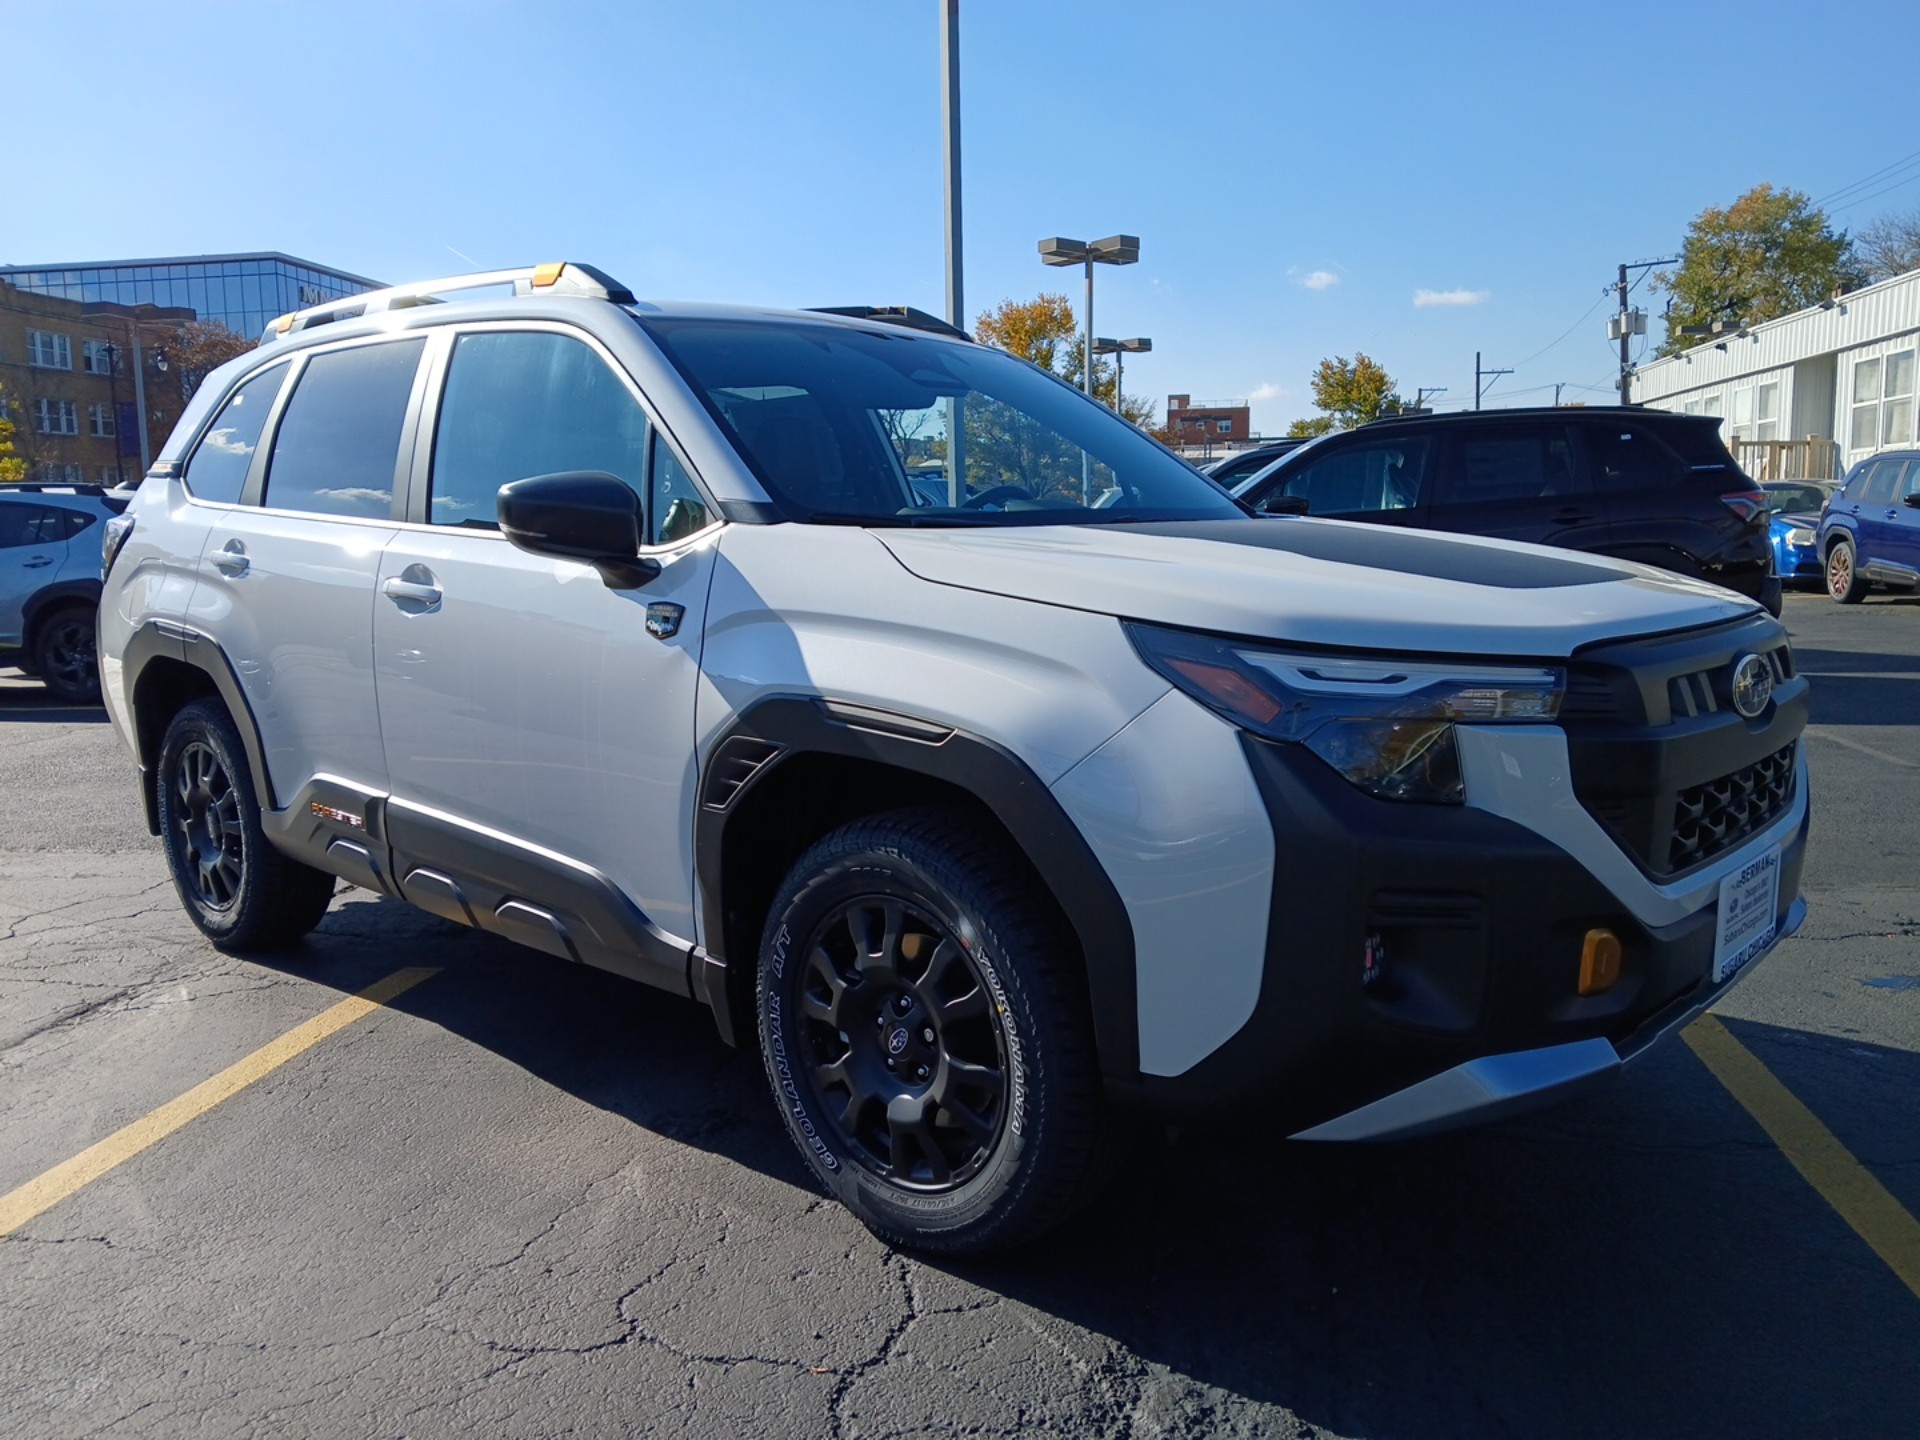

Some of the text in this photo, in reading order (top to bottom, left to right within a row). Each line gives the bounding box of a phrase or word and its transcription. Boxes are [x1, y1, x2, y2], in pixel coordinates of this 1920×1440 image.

[1740, 855, 1770, 883] BERMAN
[1720, 926, 1775, 979] SUBARU CHICAGO
[770, 923, 840, 1171] GEOLANDAR A/T
[977, 947, 1028, 1136] YOKOHAMA
